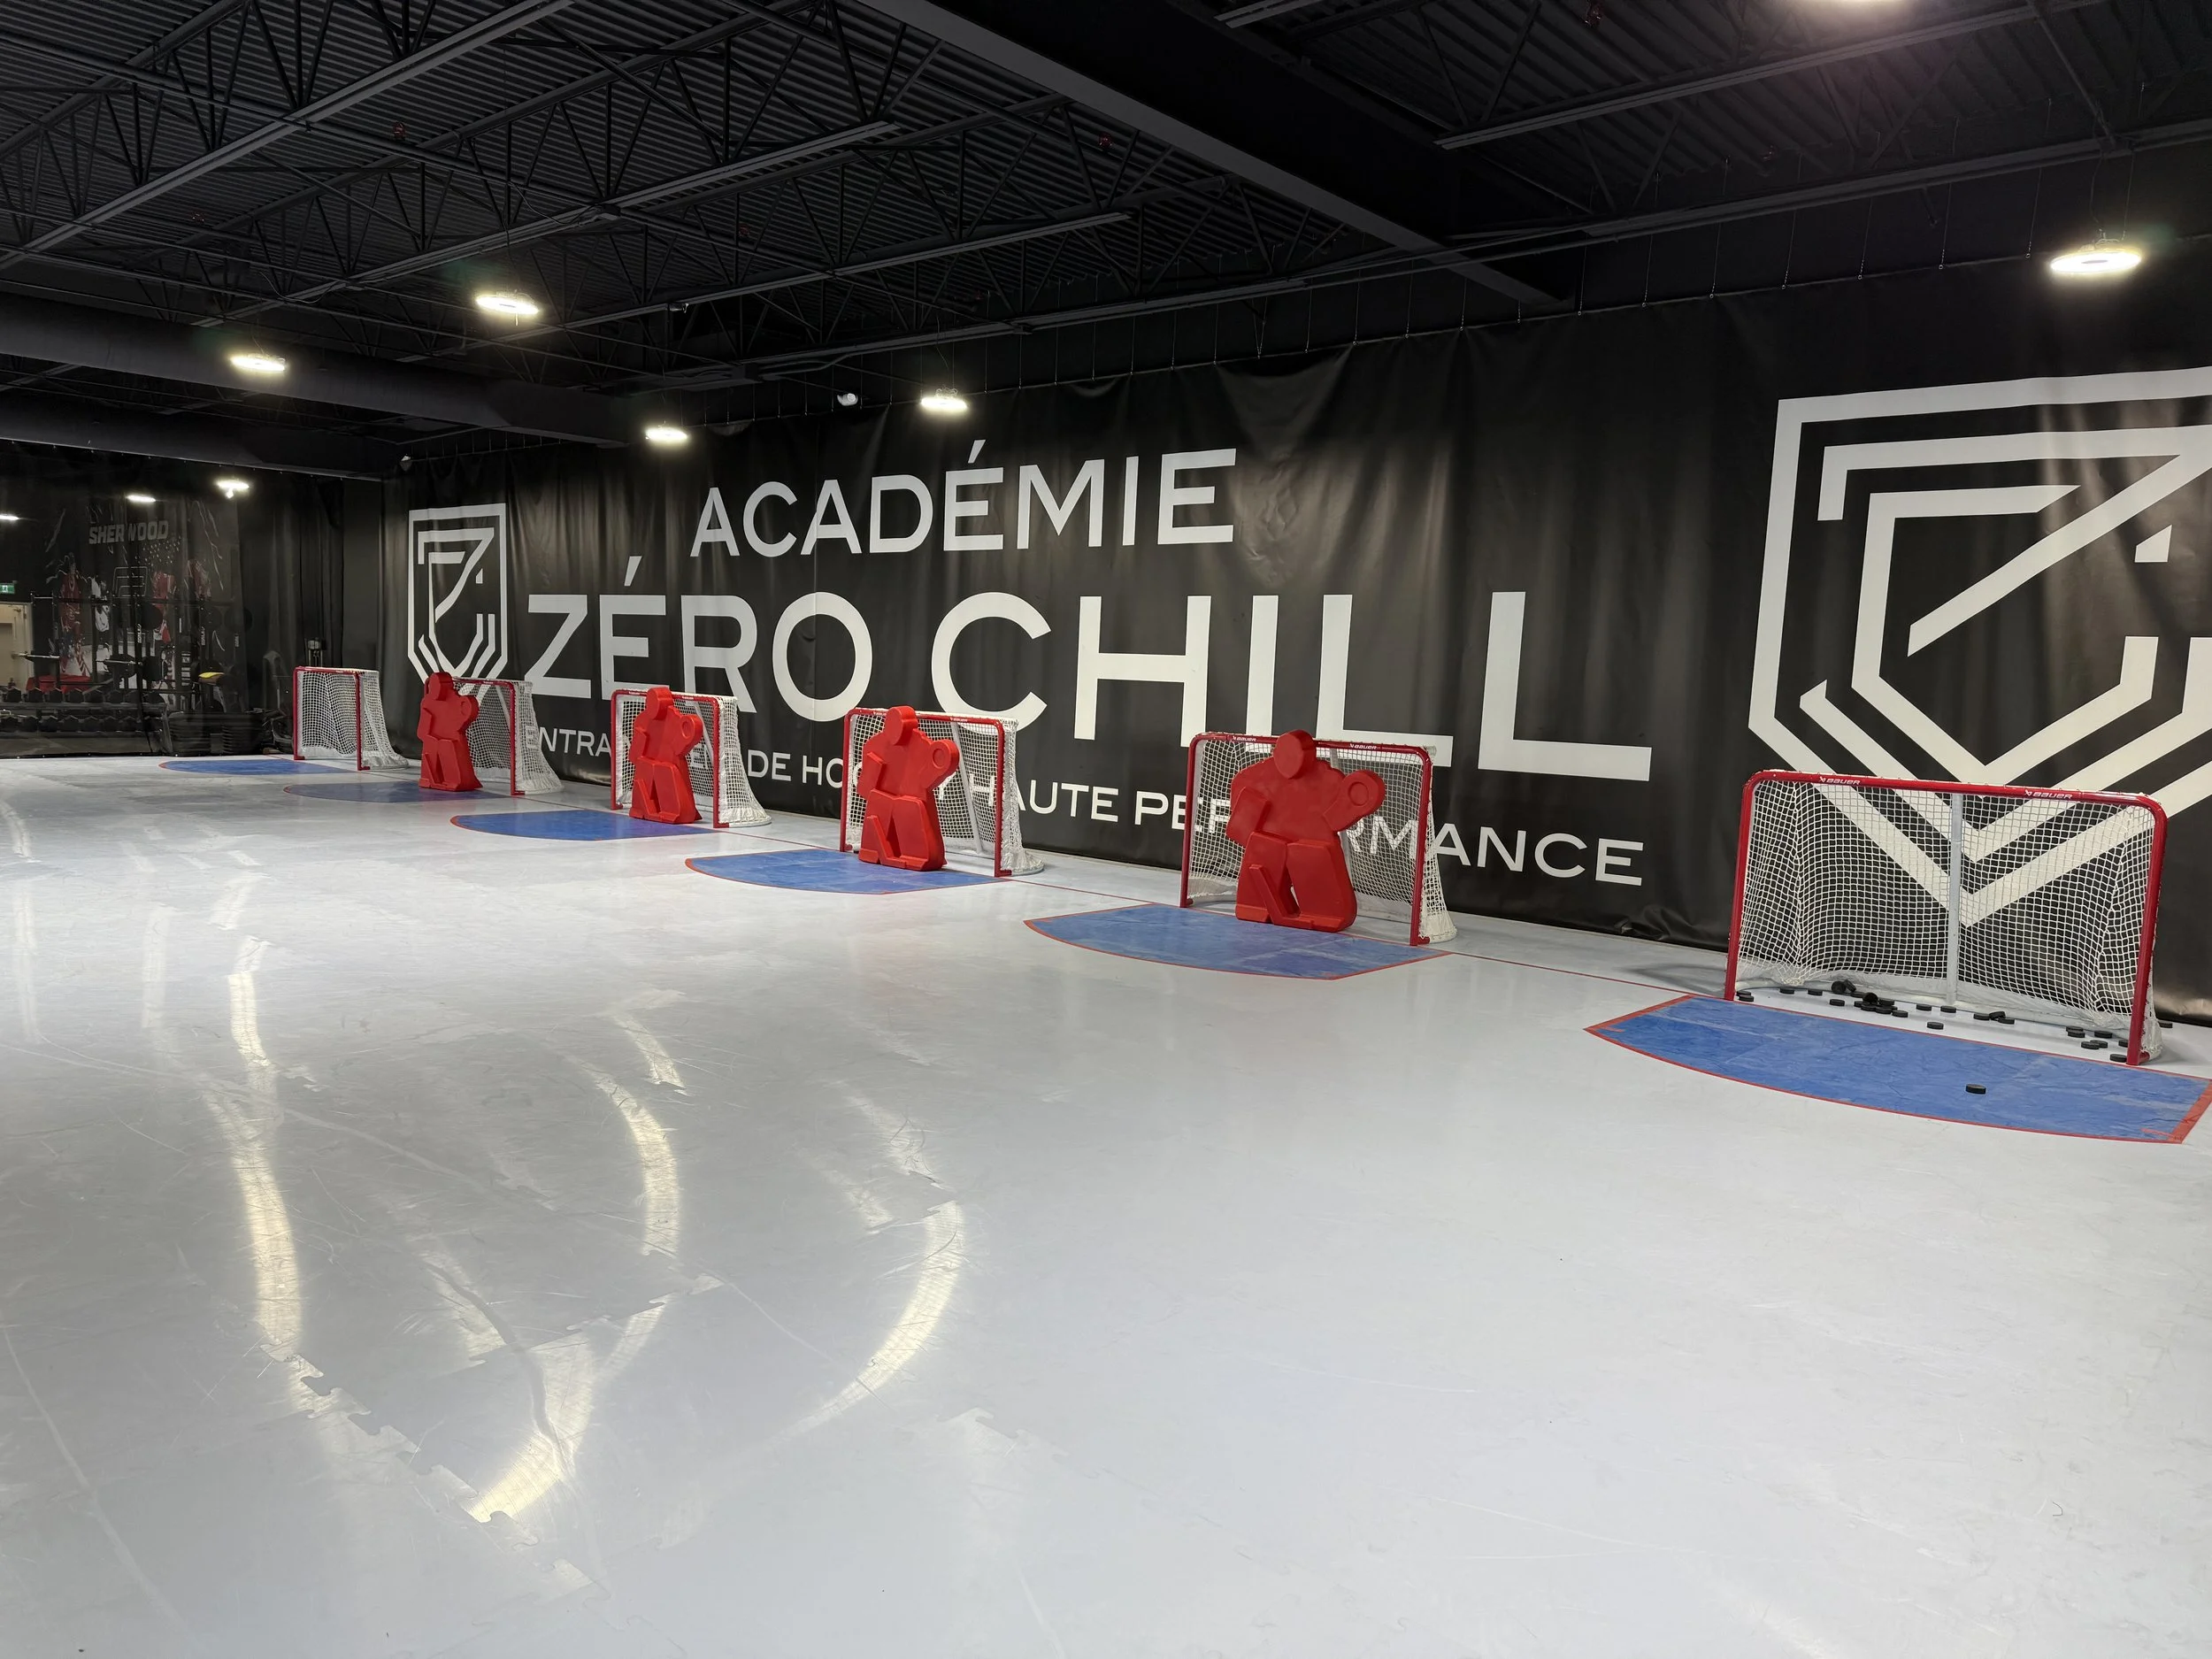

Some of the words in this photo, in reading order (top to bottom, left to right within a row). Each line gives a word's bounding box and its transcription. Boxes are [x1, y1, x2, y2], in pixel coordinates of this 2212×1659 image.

[690, 439, 1237, 557] ACADÉMIE
[89, 520, 169, 544] SHERWOOD
[524, 556, 873, 722] ZÉRO
[932, 591, 1653, 782] CHILL
[748, 749, 792, 782] DE
[2032, 791, 2073, 800] BAUER
